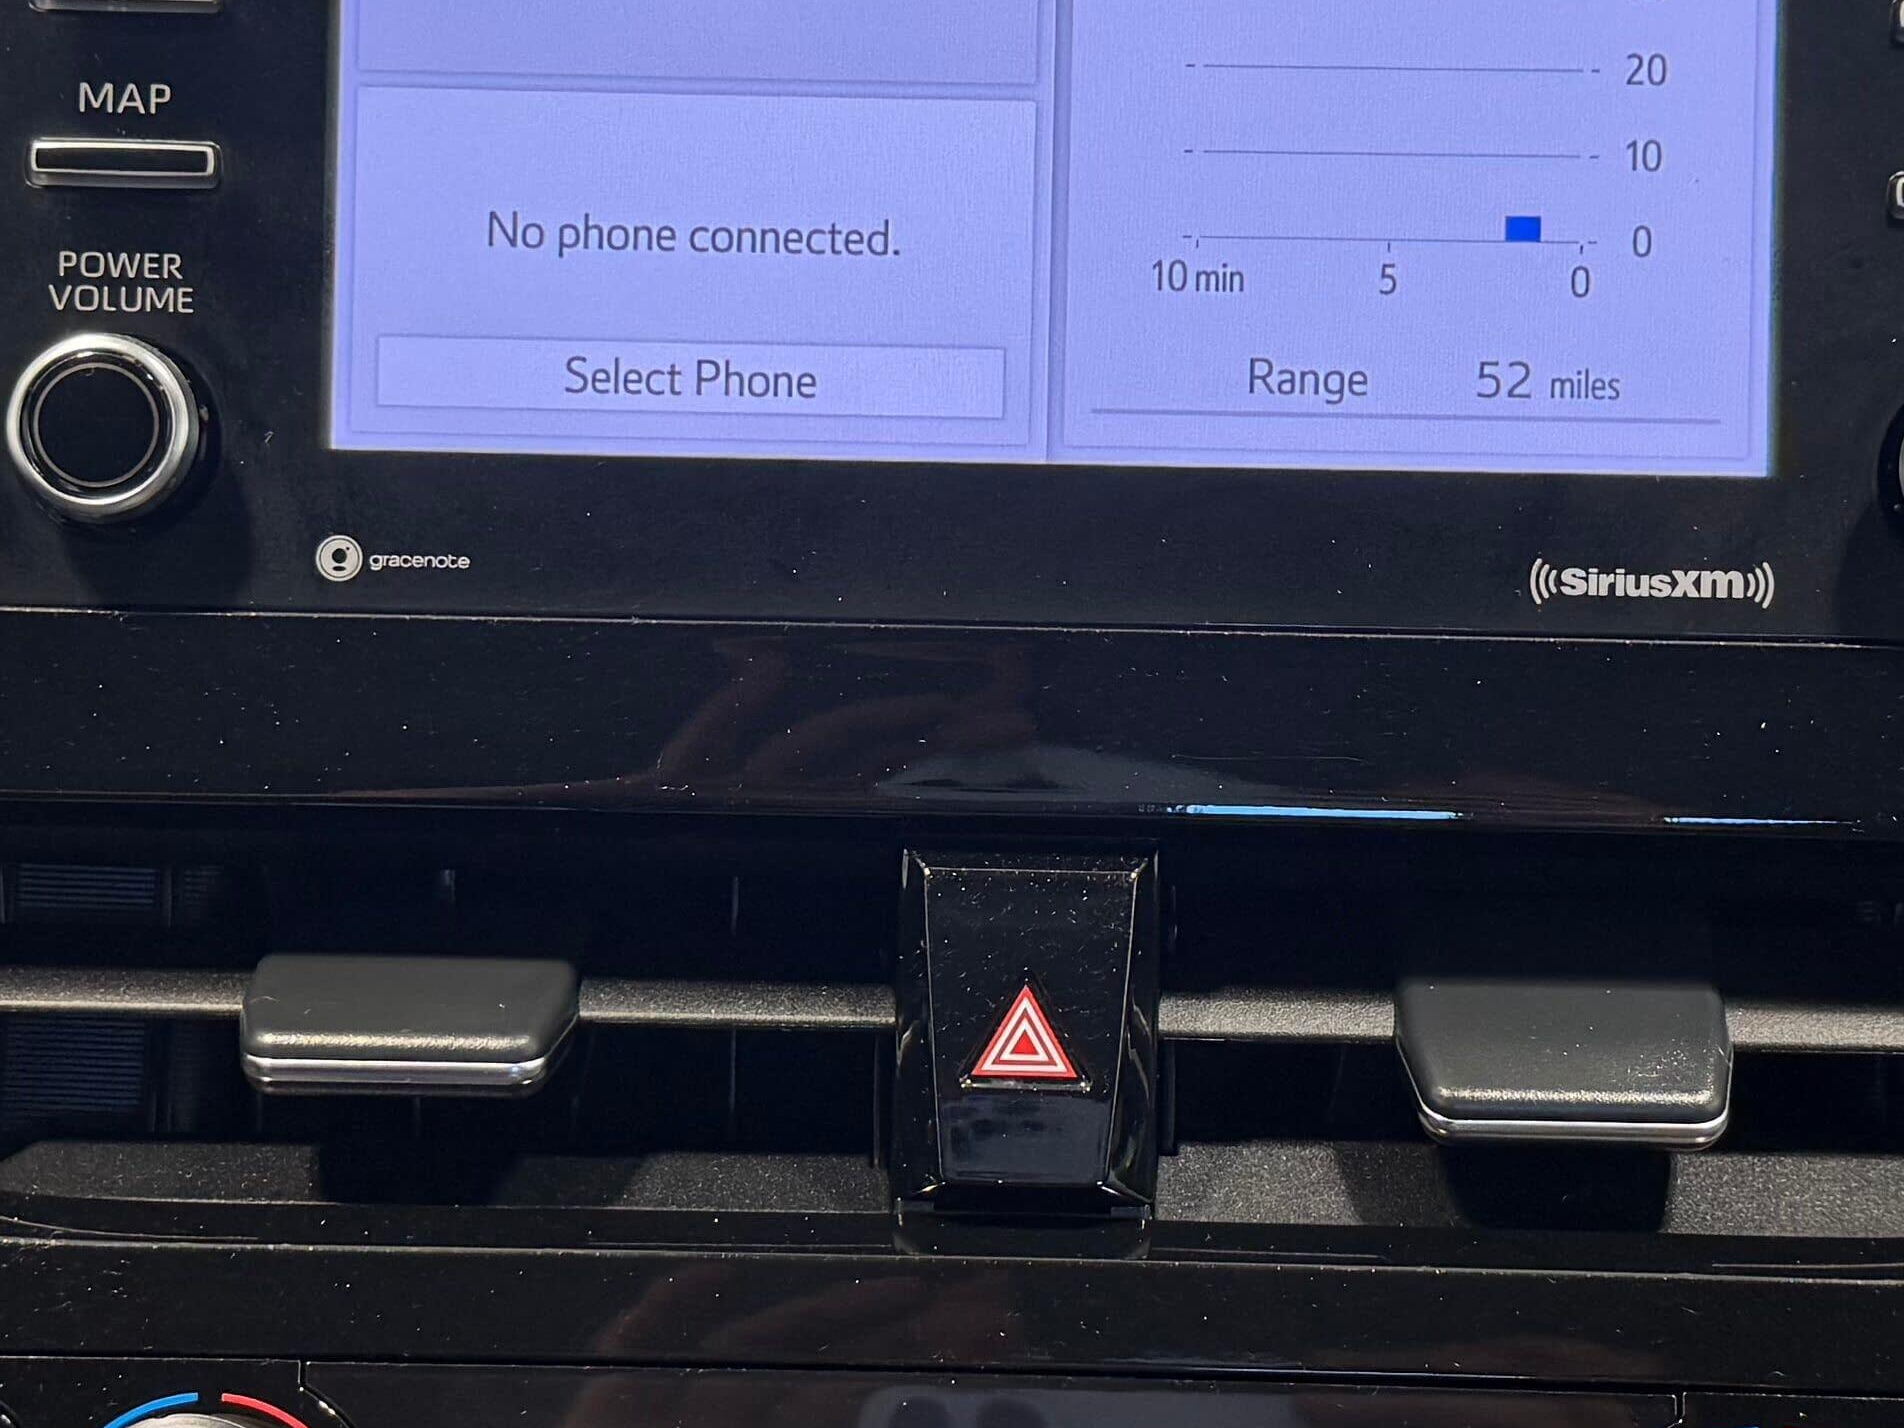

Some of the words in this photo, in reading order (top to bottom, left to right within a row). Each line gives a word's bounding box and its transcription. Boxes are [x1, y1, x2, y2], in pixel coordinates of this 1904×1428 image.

[1625, 53, 1668, 87] 20
[78, 82, 172, 115] MAP
[1625, 139, 1662, 172] 10
[487, 209, 545, 250] No
[558, 212, 676, 258] phone
[689, 218, 901, 257] connected.
[1632, 225, 1653, 258] 0
[57, 251, 183, 280] POWER
[1151, 259, 1188, 293] 10
[1194, 264, 1245, 294] min
[1380, 263, 1398, 295] 5
[1570, 266, 1591, 298] 0
[48, 285, 195, 314] VOLUME
[564, 356, 681, 397] Select
[696, 358, 818, 399] Phone
[1247, 356, 1369, 405] Range
[1476, 361, 1532, 400] 52
[1550, 370, 1621, 401] miles
[368, 551, 471, 572] gracenote
